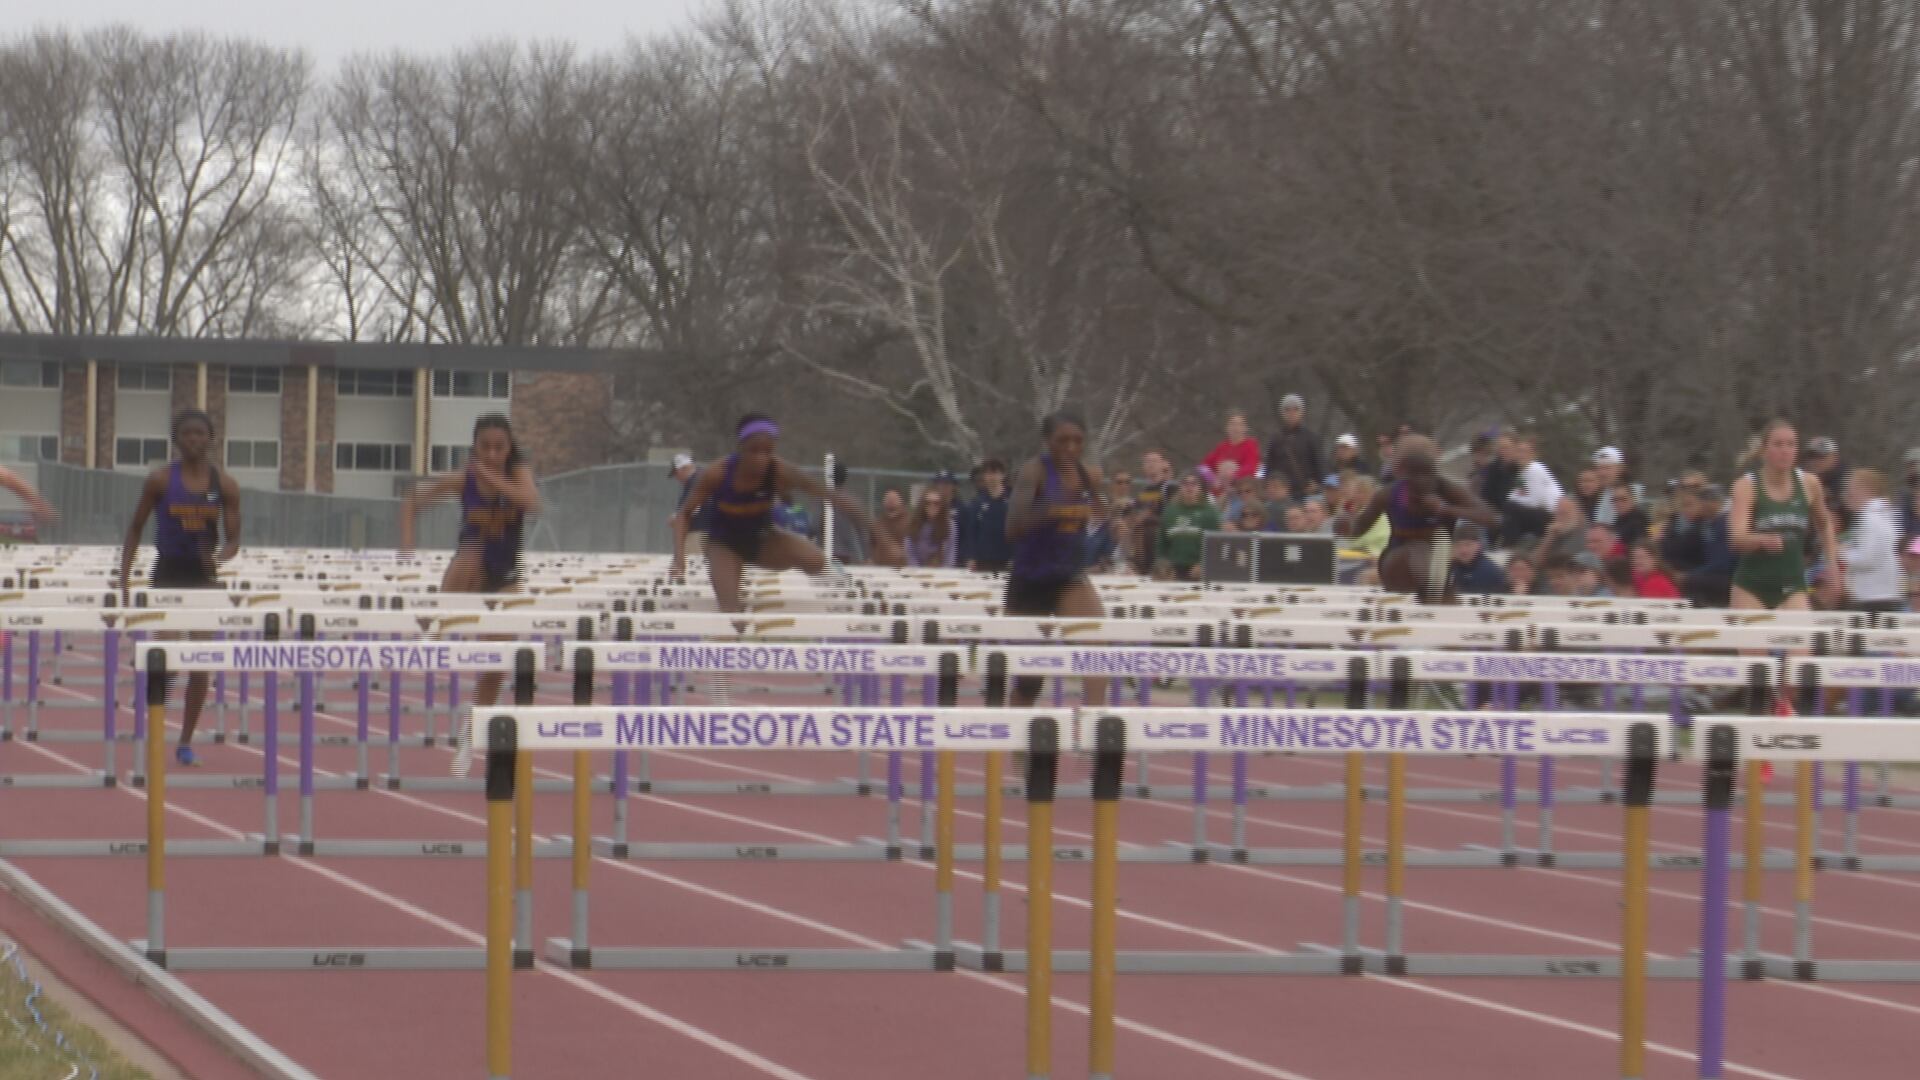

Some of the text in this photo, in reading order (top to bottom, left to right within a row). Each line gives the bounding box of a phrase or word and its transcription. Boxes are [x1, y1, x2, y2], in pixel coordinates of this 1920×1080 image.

[67, 596, 95, 604] UCS
[155, 596, 350, 606] UCS UCS
[411, 599, 605, 610] UCS UCS
[661, 602, 854, 613] UCS UCS
[9, 616, 253, 625] UCS UCS
[324, 618, 566, 630] UCS UCS
[640, 621, 881, 633] UCS UCS
[948, 624, 1188, 636] UCS UCS
[1257, 628, 1496, 642] UCS UCS
[1566, 632, 1804, 645] UCS UCS
[1872, 637, 1907, 647] UCS
[180, 646, 502, 669] UCS MINNESOTA STATE UCS
[607, 646, 926, 671] UCS MINNESOTA STATE UCS
[1019, 651, 1336, 676] UCS MINNESOTA STATE UCS
[1423, 656, 1738, 682] UCS MINNESOTA STATE UCS
[1832, 667, 1877, 680] UCS
[537, 713, 1010, 746] UCS MINNESOTA STATE UCS
[1144, 715, 1610, 751] UCS MINNESOTA STATE UCS
[1753, 734, 1822, 750] UCS
[736, 783, 770, 793] UCS
[422, 845, 463, 856] UCS
[736, 847, 777, 858] UCS
[312, 953, 365, 966] UCS
[736, 954, 789, 967] UCS
[1545, 961, 1601, 975] UCS
